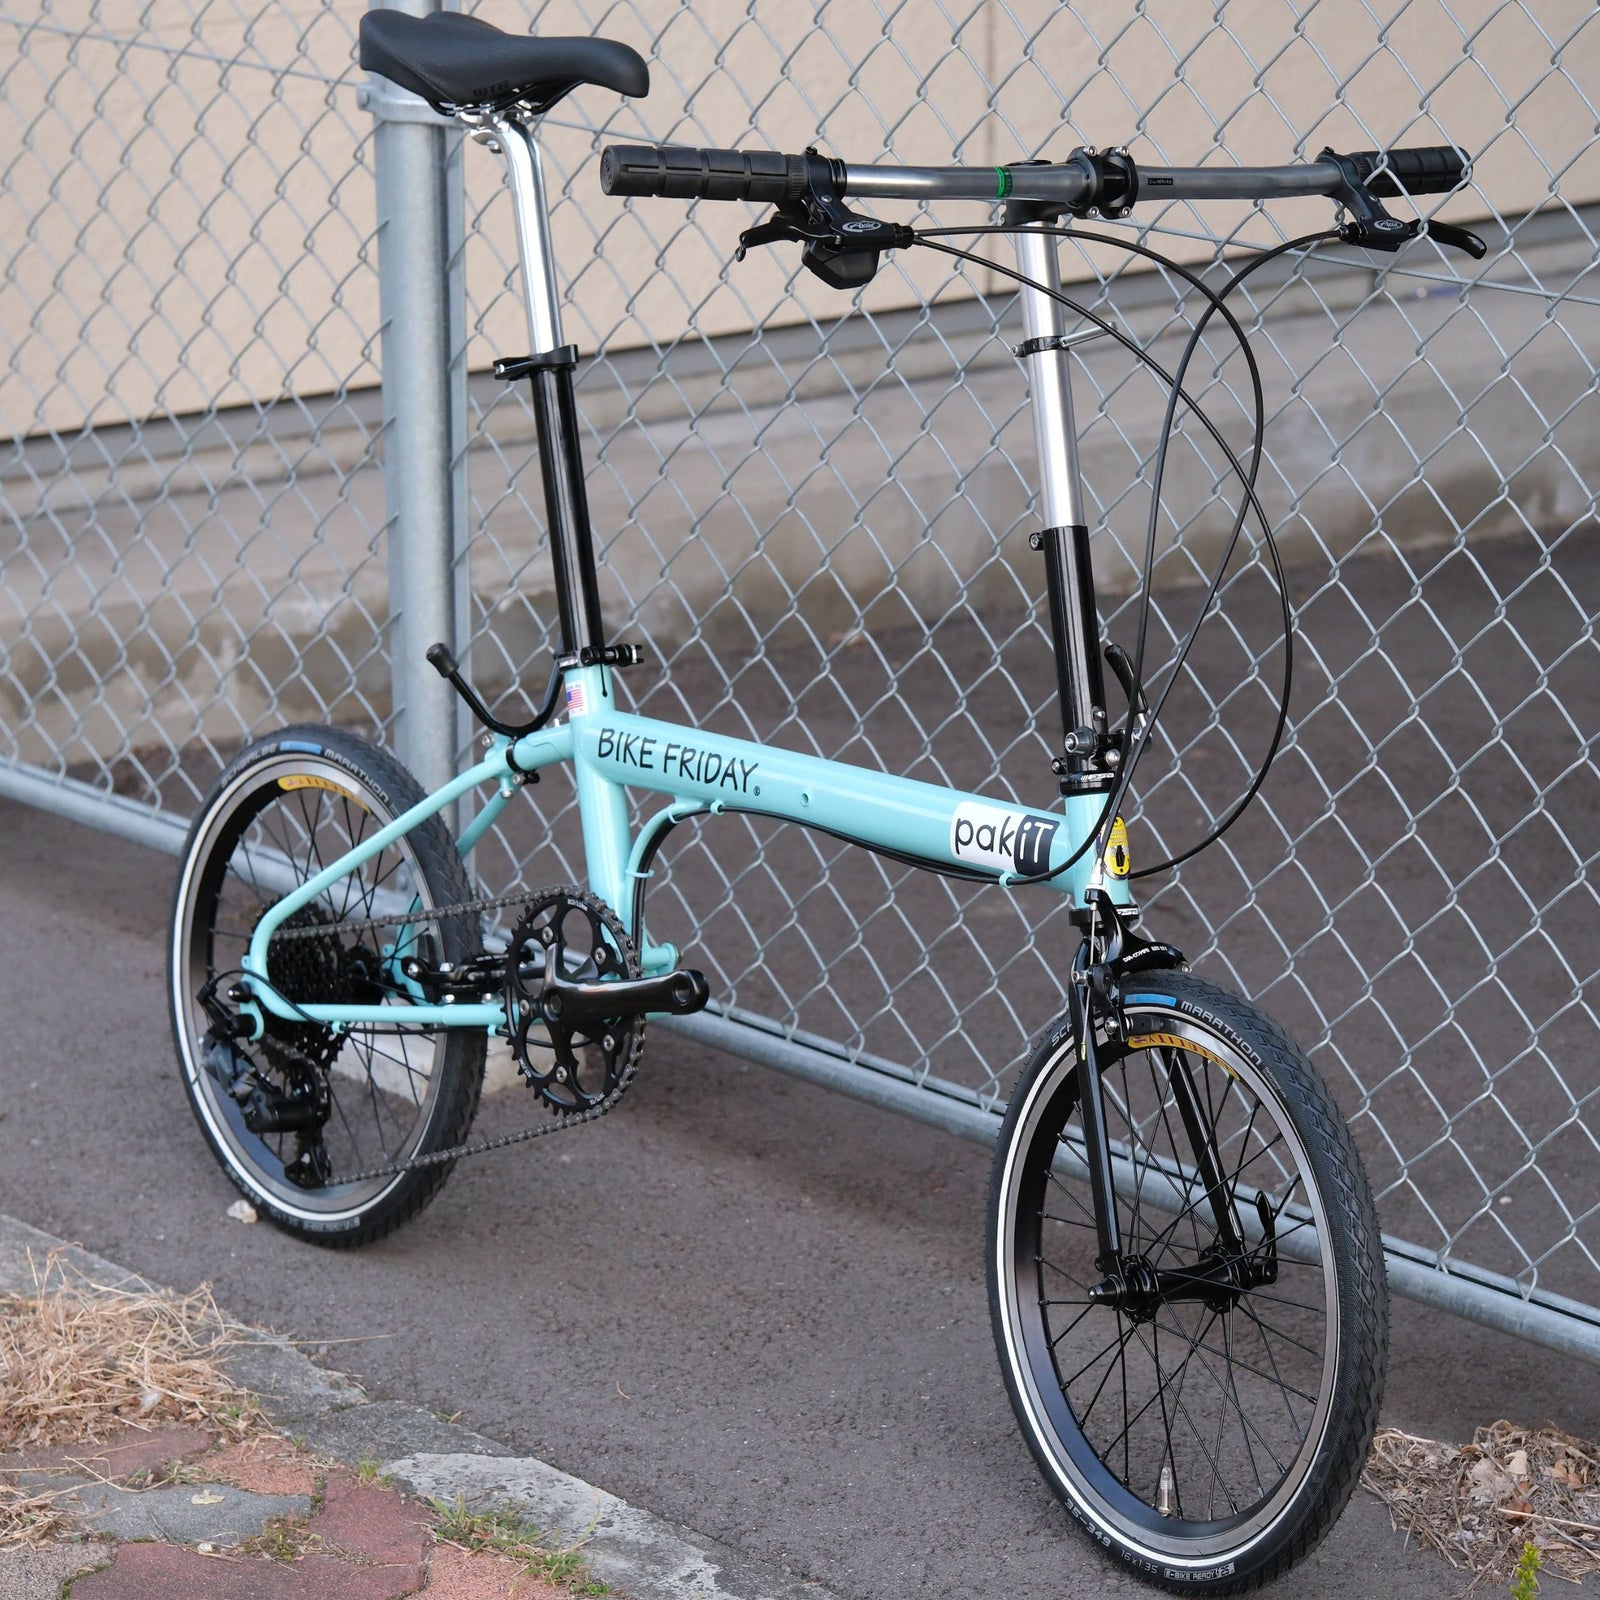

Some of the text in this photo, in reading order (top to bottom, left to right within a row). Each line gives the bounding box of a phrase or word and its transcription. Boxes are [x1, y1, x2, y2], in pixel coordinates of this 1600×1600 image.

[324, 748, 390, 803] MARATHON
[598, 728, 758, 793] BIKE FRIDAY
[1181, 1000, 1262, 1065] MARATHON
[1065, 1498, 1111, 1548] 35-349
[1192, 1570, 1215, 1580] READY
